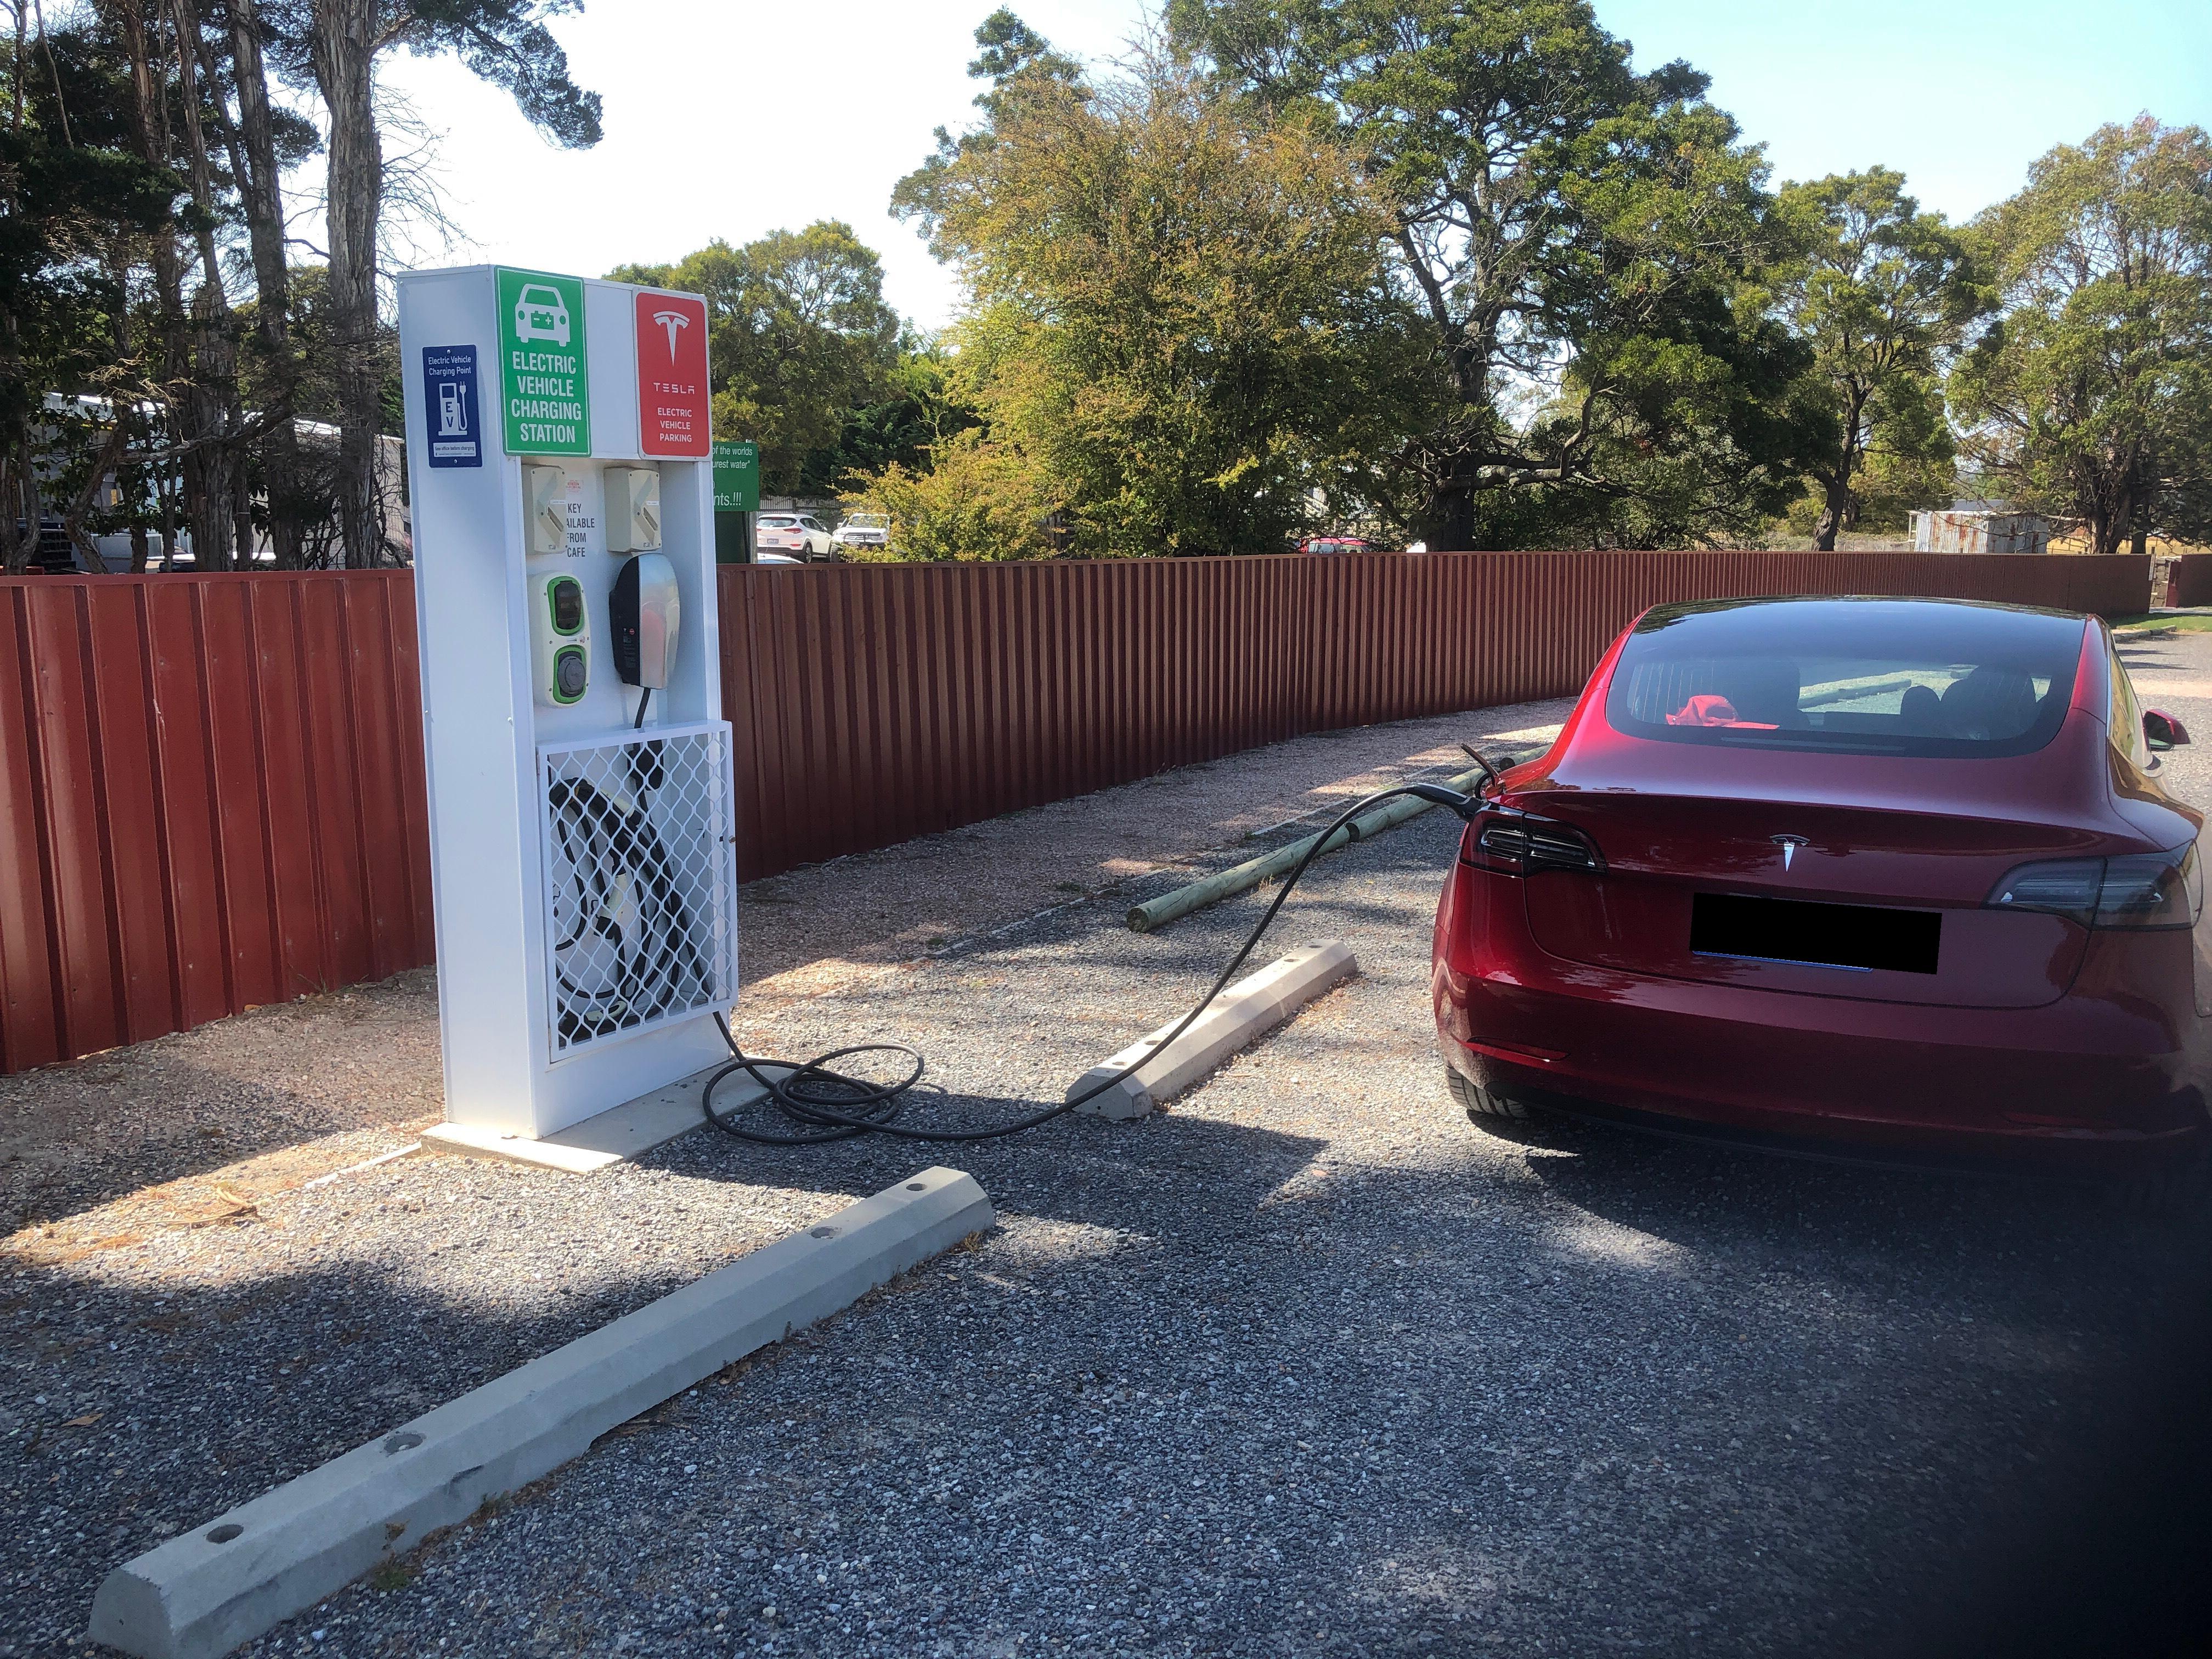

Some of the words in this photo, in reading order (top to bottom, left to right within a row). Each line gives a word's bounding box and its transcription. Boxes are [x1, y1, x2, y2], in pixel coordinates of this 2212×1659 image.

[428, 356, 450, 365] Electric
[512, 351, 576, 374] ELECTRIC
[428, 367, 455, 377] Charging
[456, 366, 471, 374] Point
[517, 375, 574, 397] VEHICLE
[653, 382, 695, 394] TESLA
[511, 398, 582, 421] CHARGING
[657, 407, 692, 417] ELECTRIC
[660, 420, 691, 430] VEHICLE
[520, 422, 575, 443] STATION
[659, 433, 692, 442] PARKING
[720, 445, 731, 455] the
[732, 447, 753, 456] worlds
[713, 460, 729, 469] urest
[714, 492, 742, 506] nts.!!!
[567, 503, 582, 514] KEY
[566, 518, 595, 528] AILABLE
[567, 547, 585, 557] CAFE
